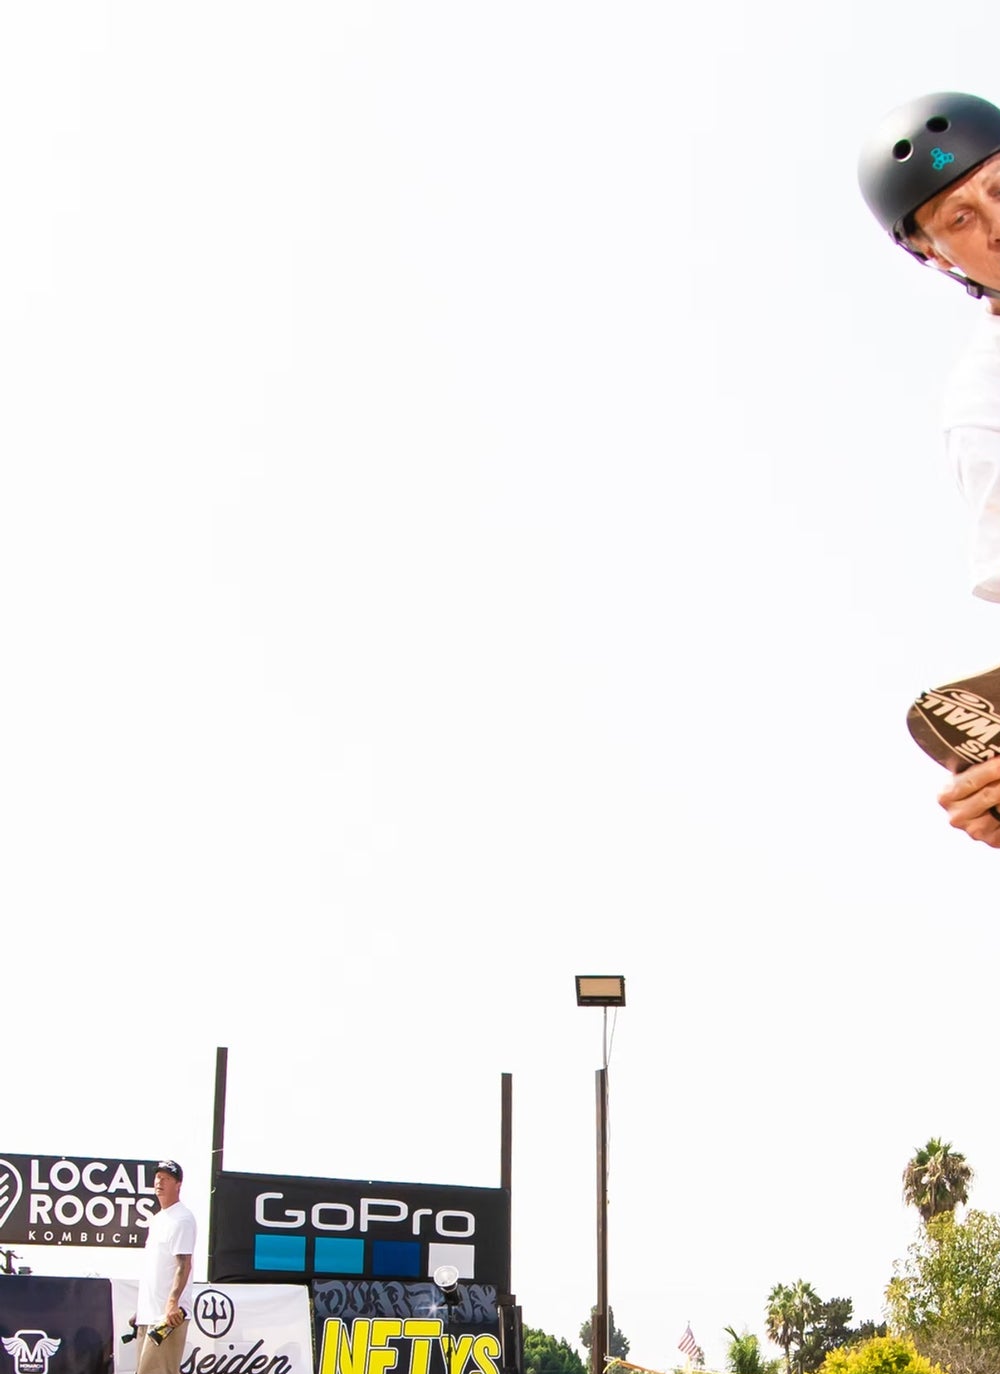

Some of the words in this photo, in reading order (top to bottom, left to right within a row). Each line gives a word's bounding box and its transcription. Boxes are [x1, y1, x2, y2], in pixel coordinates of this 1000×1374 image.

[30, 1159, 156, 1196] LOCAL
[29, 1193, 155, 1229] ROOTS
[254, 1192, 476, 1238] GoPro
[28, 1230, 139, 1244] KOMBUCH
